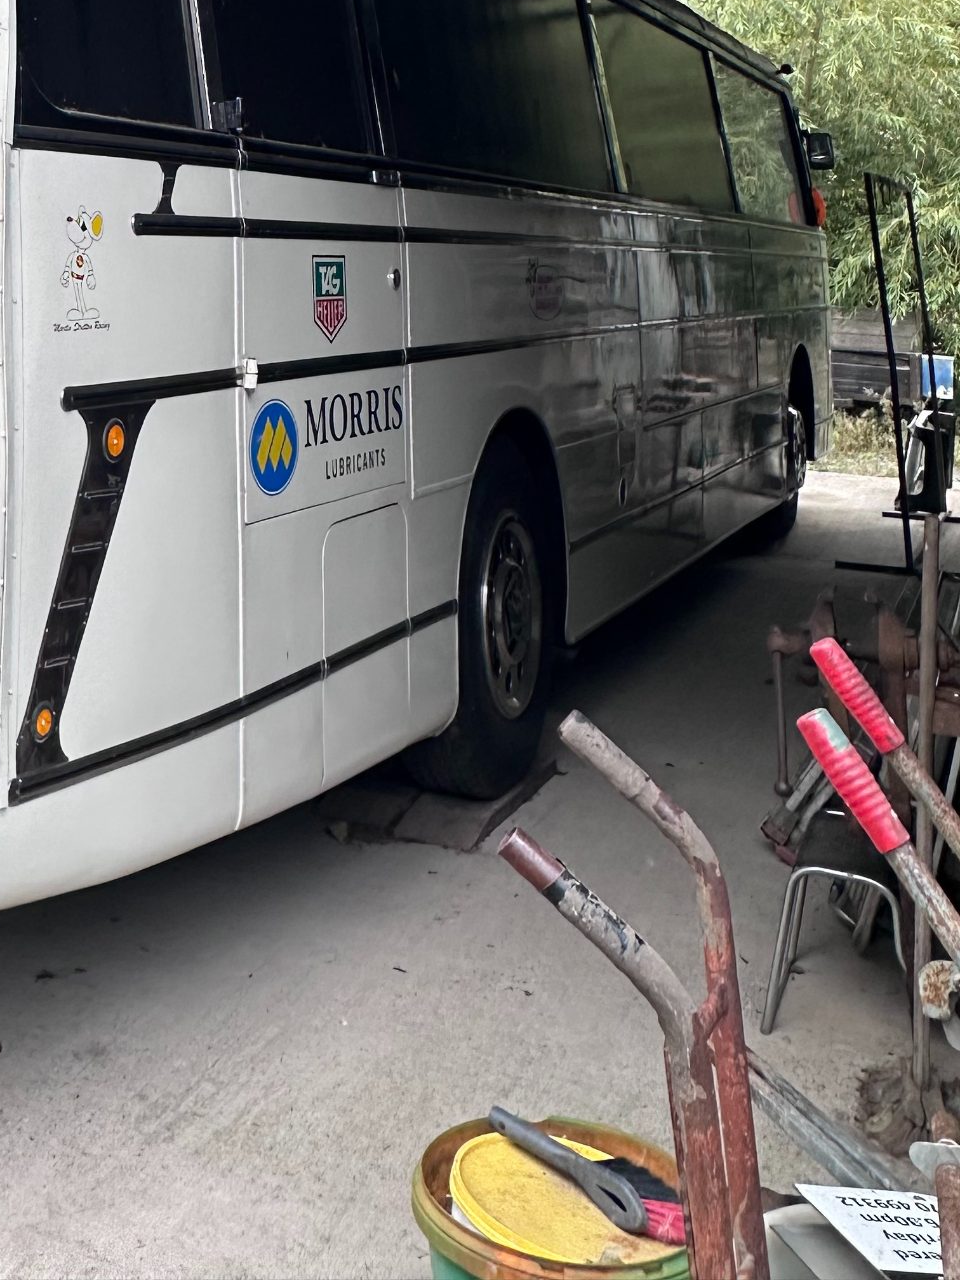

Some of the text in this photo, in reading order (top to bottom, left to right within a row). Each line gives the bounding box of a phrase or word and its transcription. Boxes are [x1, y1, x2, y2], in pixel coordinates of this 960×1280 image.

[318, 265, 341, 296] TAG
[317, 301, 344, 332] HEUER
[304, 385, 403, 448] MORRIS
[325, 447, 386, 480] LUBRICANTS
[835, 1196, 911, 1210] 499312
[883, 1230, 941, 1245] riday
